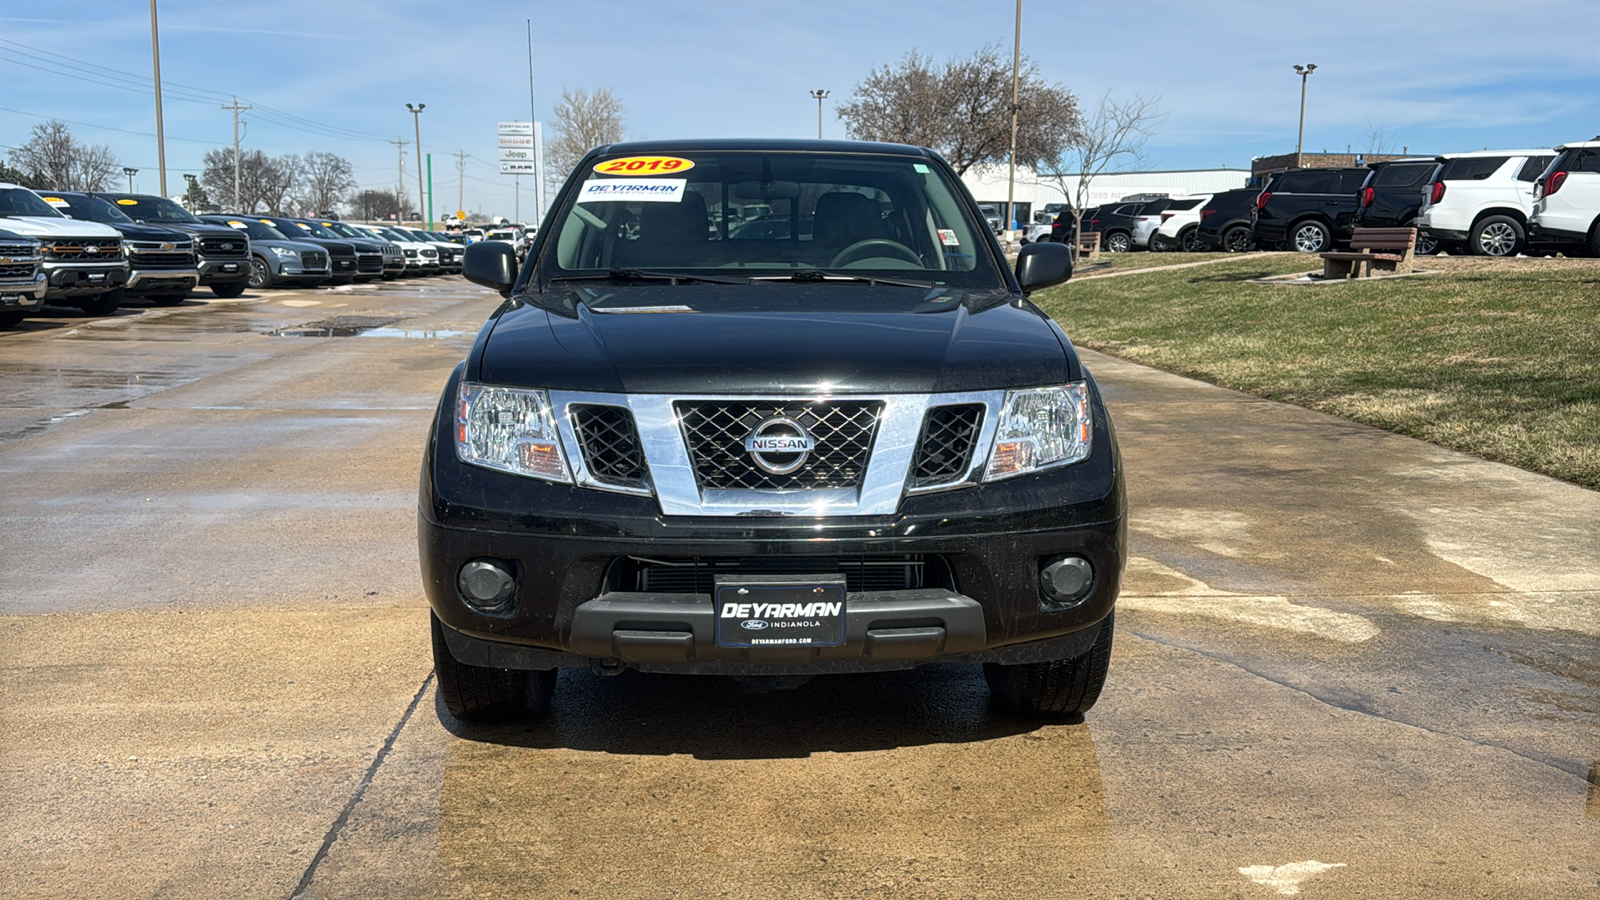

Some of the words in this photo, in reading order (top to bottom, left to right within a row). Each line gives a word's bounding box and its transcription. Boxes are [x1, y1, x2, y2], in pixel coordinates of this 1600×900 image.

[505, 150, 527, 158] Jeep
[604, 160, 683, 171] 2019
[752, 440, 808, 448] NISSAN
[720, 602, 842, 618] DEYARMAN
